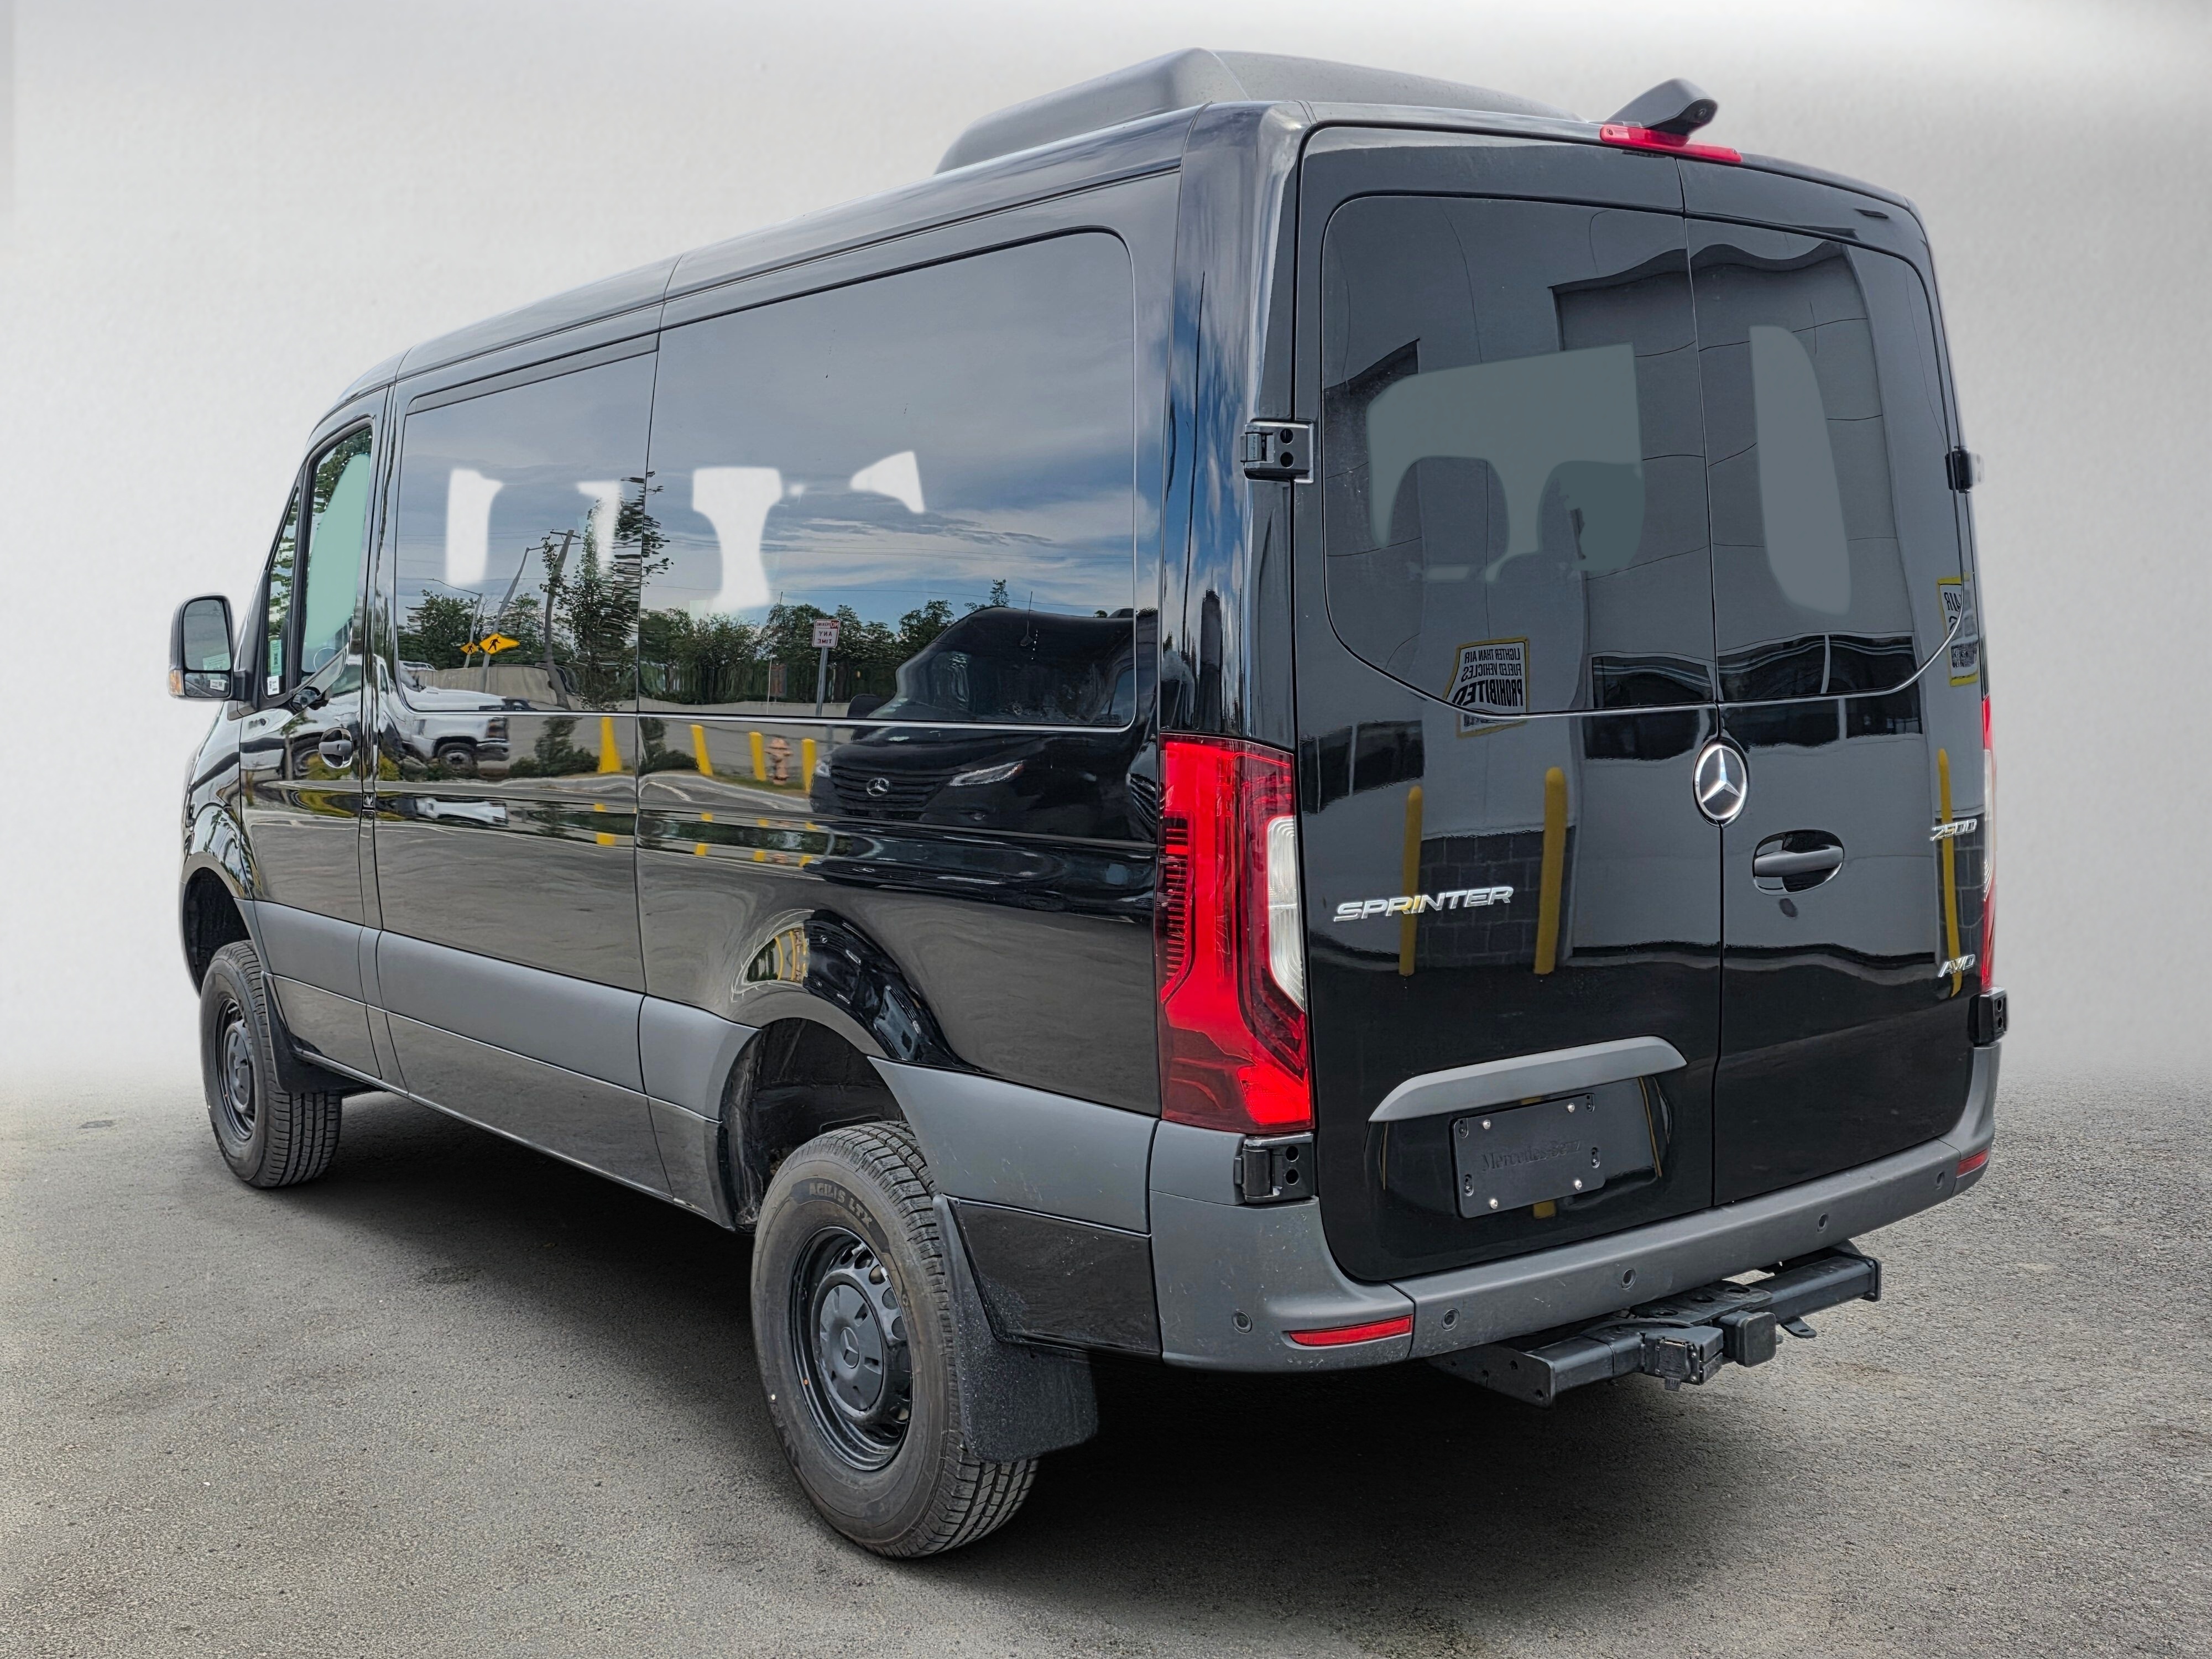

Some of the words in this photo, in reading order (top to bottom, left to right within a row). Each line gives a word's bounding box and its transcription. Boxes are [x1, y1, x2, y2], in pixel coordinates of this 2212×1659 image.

[1333, 886, 1514, 922] SPRINTER
[1937, 954, 1976, 978] AWD
[808, 1182, 846, 1203] AGILIS
